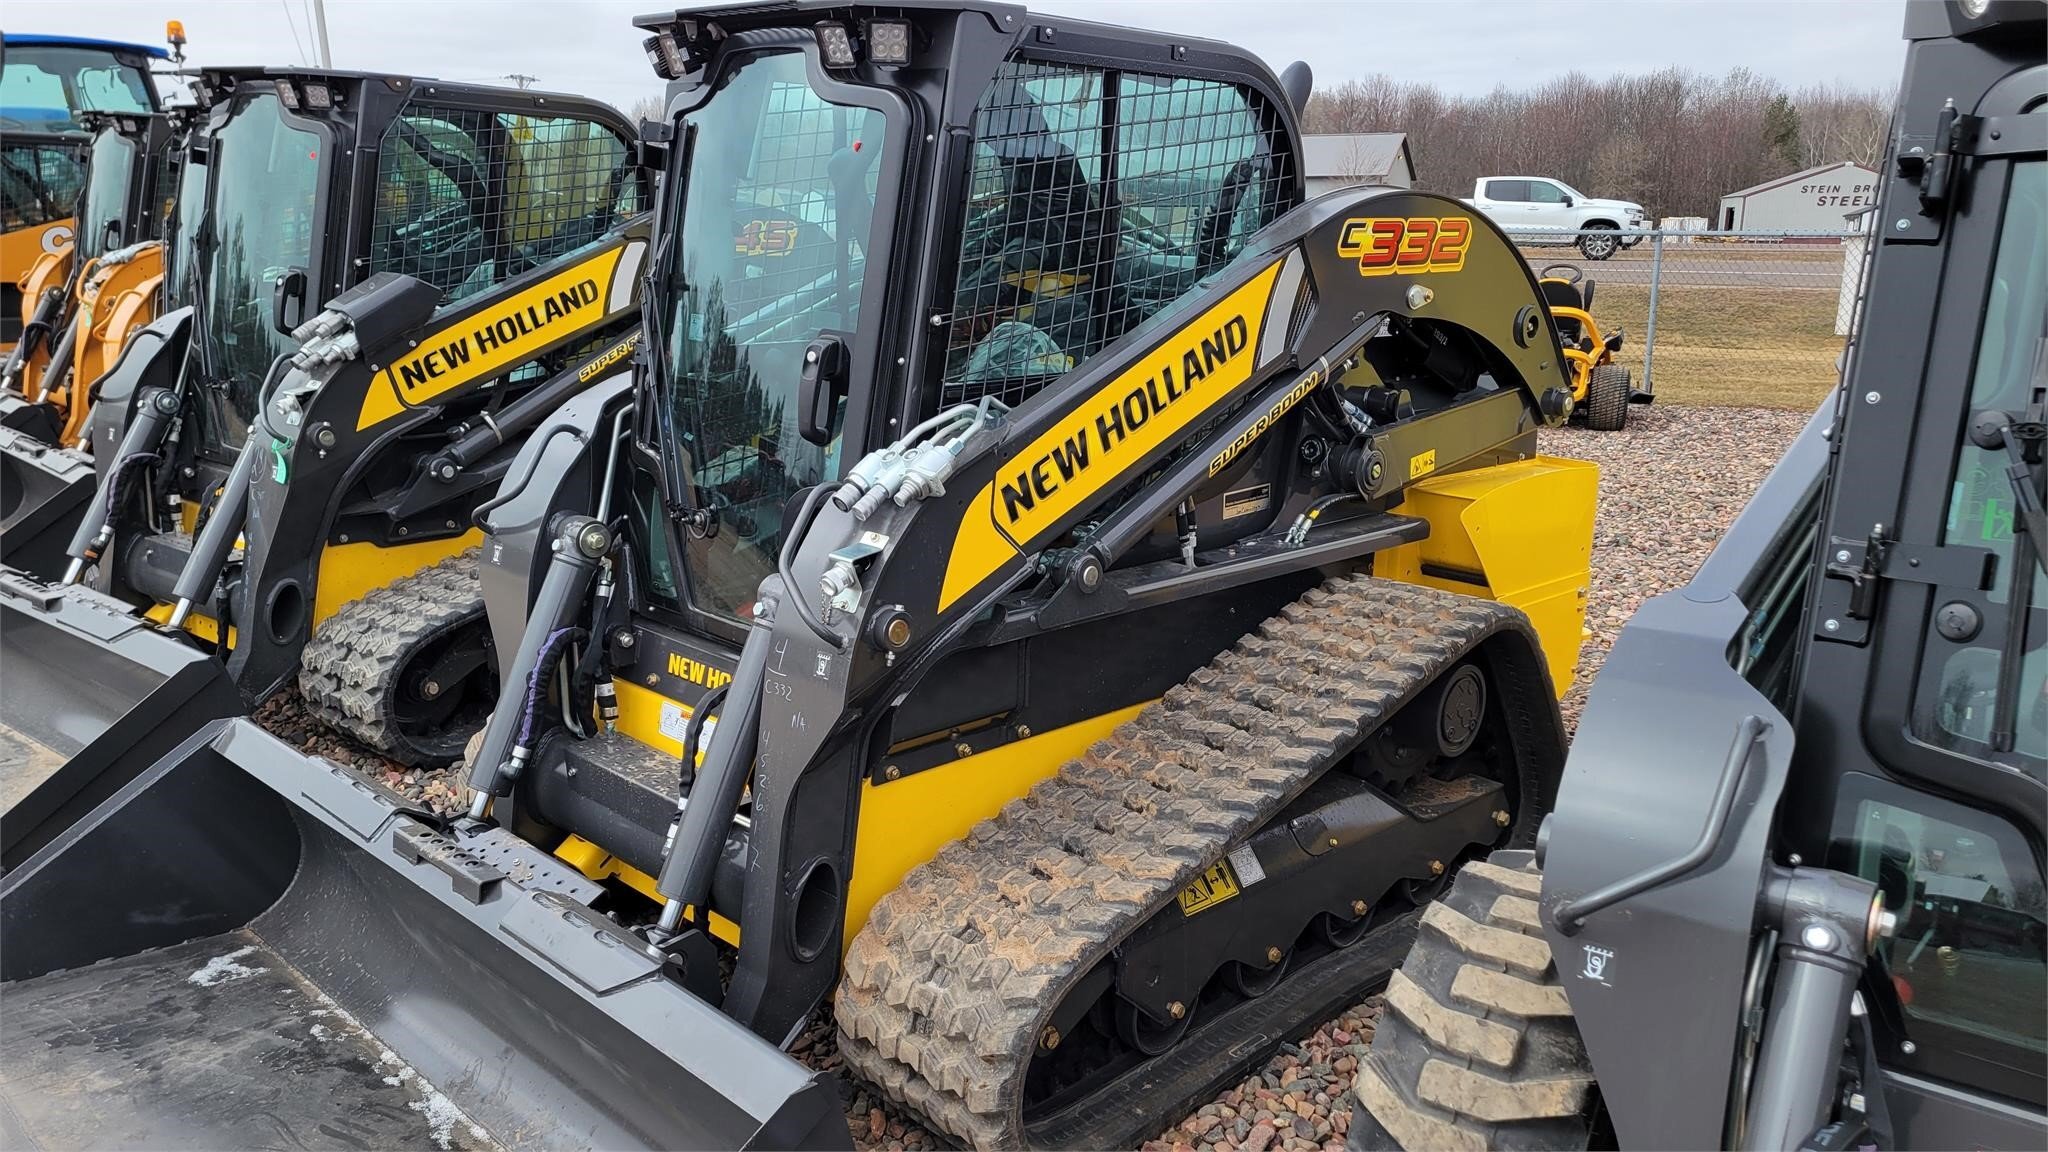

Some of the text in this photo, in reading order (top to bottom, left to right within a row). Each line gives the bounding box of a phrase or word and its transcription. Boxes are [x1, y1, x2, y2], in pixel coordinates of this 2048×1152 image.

[1800, 185, 1841, 194] STEIN
[1817, 196, 1873, 206] STEEL
[1339, 219, 1472, 273] C332
[399, 278, 599, 390] NEW HOLLAND
[578, 343, 628, 382] SUPER
[1000, 314, 1248, 524] NEW HOLLAND
[1209, 371, 1318, 477] SUPER BOOM
[668, 652, 706, 686] NEW
[765, 680, 792, 702] C332
